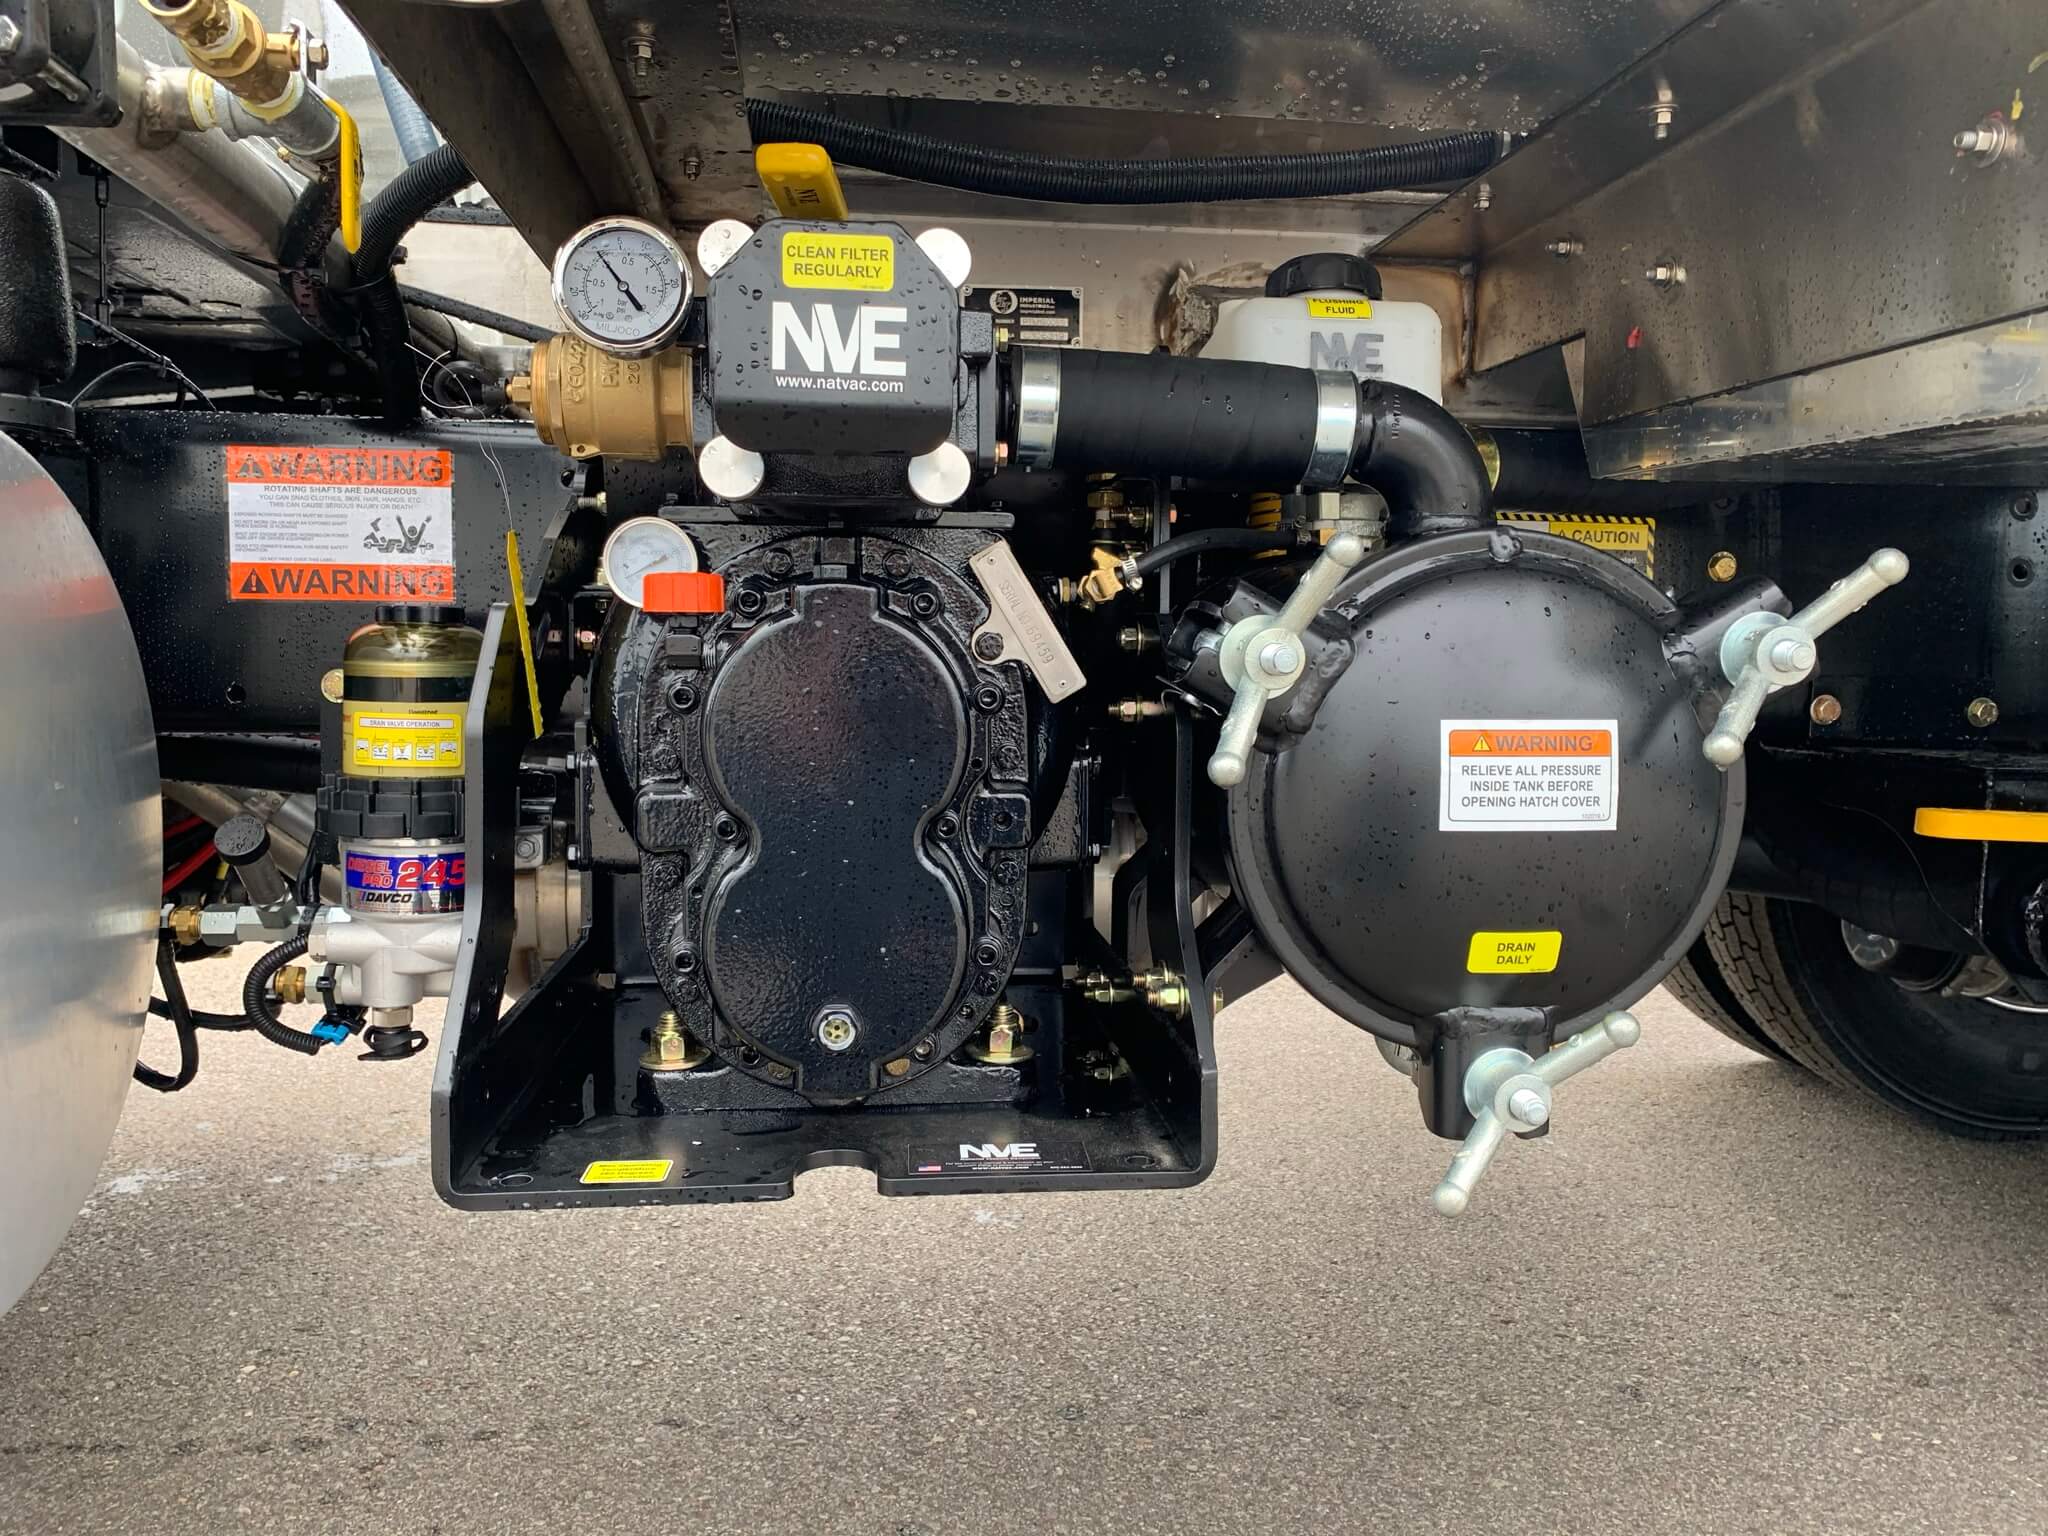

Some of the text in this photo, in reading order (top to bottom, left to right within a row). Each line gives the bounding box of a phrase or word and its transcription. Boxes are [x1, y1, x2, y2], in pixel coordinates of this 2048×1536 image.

[786, 245, 889, 262] CLEAN FILTER
[794, 263, 882, 278] REGULARLY
[1326, 306, 1356, 314] FLUID
[596, 322, 640, 336] MILJOCO
[772, 301, 908, 377] NVE
[1310, 331, 1384, 372] NVE
[775, 376, 904, 392] www.natvac.com
[268, 452, 444, 482] WARNING
[1572, 530, 1640, 544] CAUTION
[272, 568, 445, 596] WARNING
[1496, 735, 1593, 751] WARNING
[1461, 764, 1601, 776] RELIEVE ALL PRESSURE
[1470, 780, 1594, 792] INSIDE TANK BEFORE
[1461, 796, 1601, 808] OPENING HATCH COVER
[362, 872, 394, 888] PRO
[395, 858, 466, 889] 245
[1497, 942, 1536, 952] DRAIN
[1496, 955, 1532, 965] DAILY
[960, 1143, 1040, 1158] NVE
